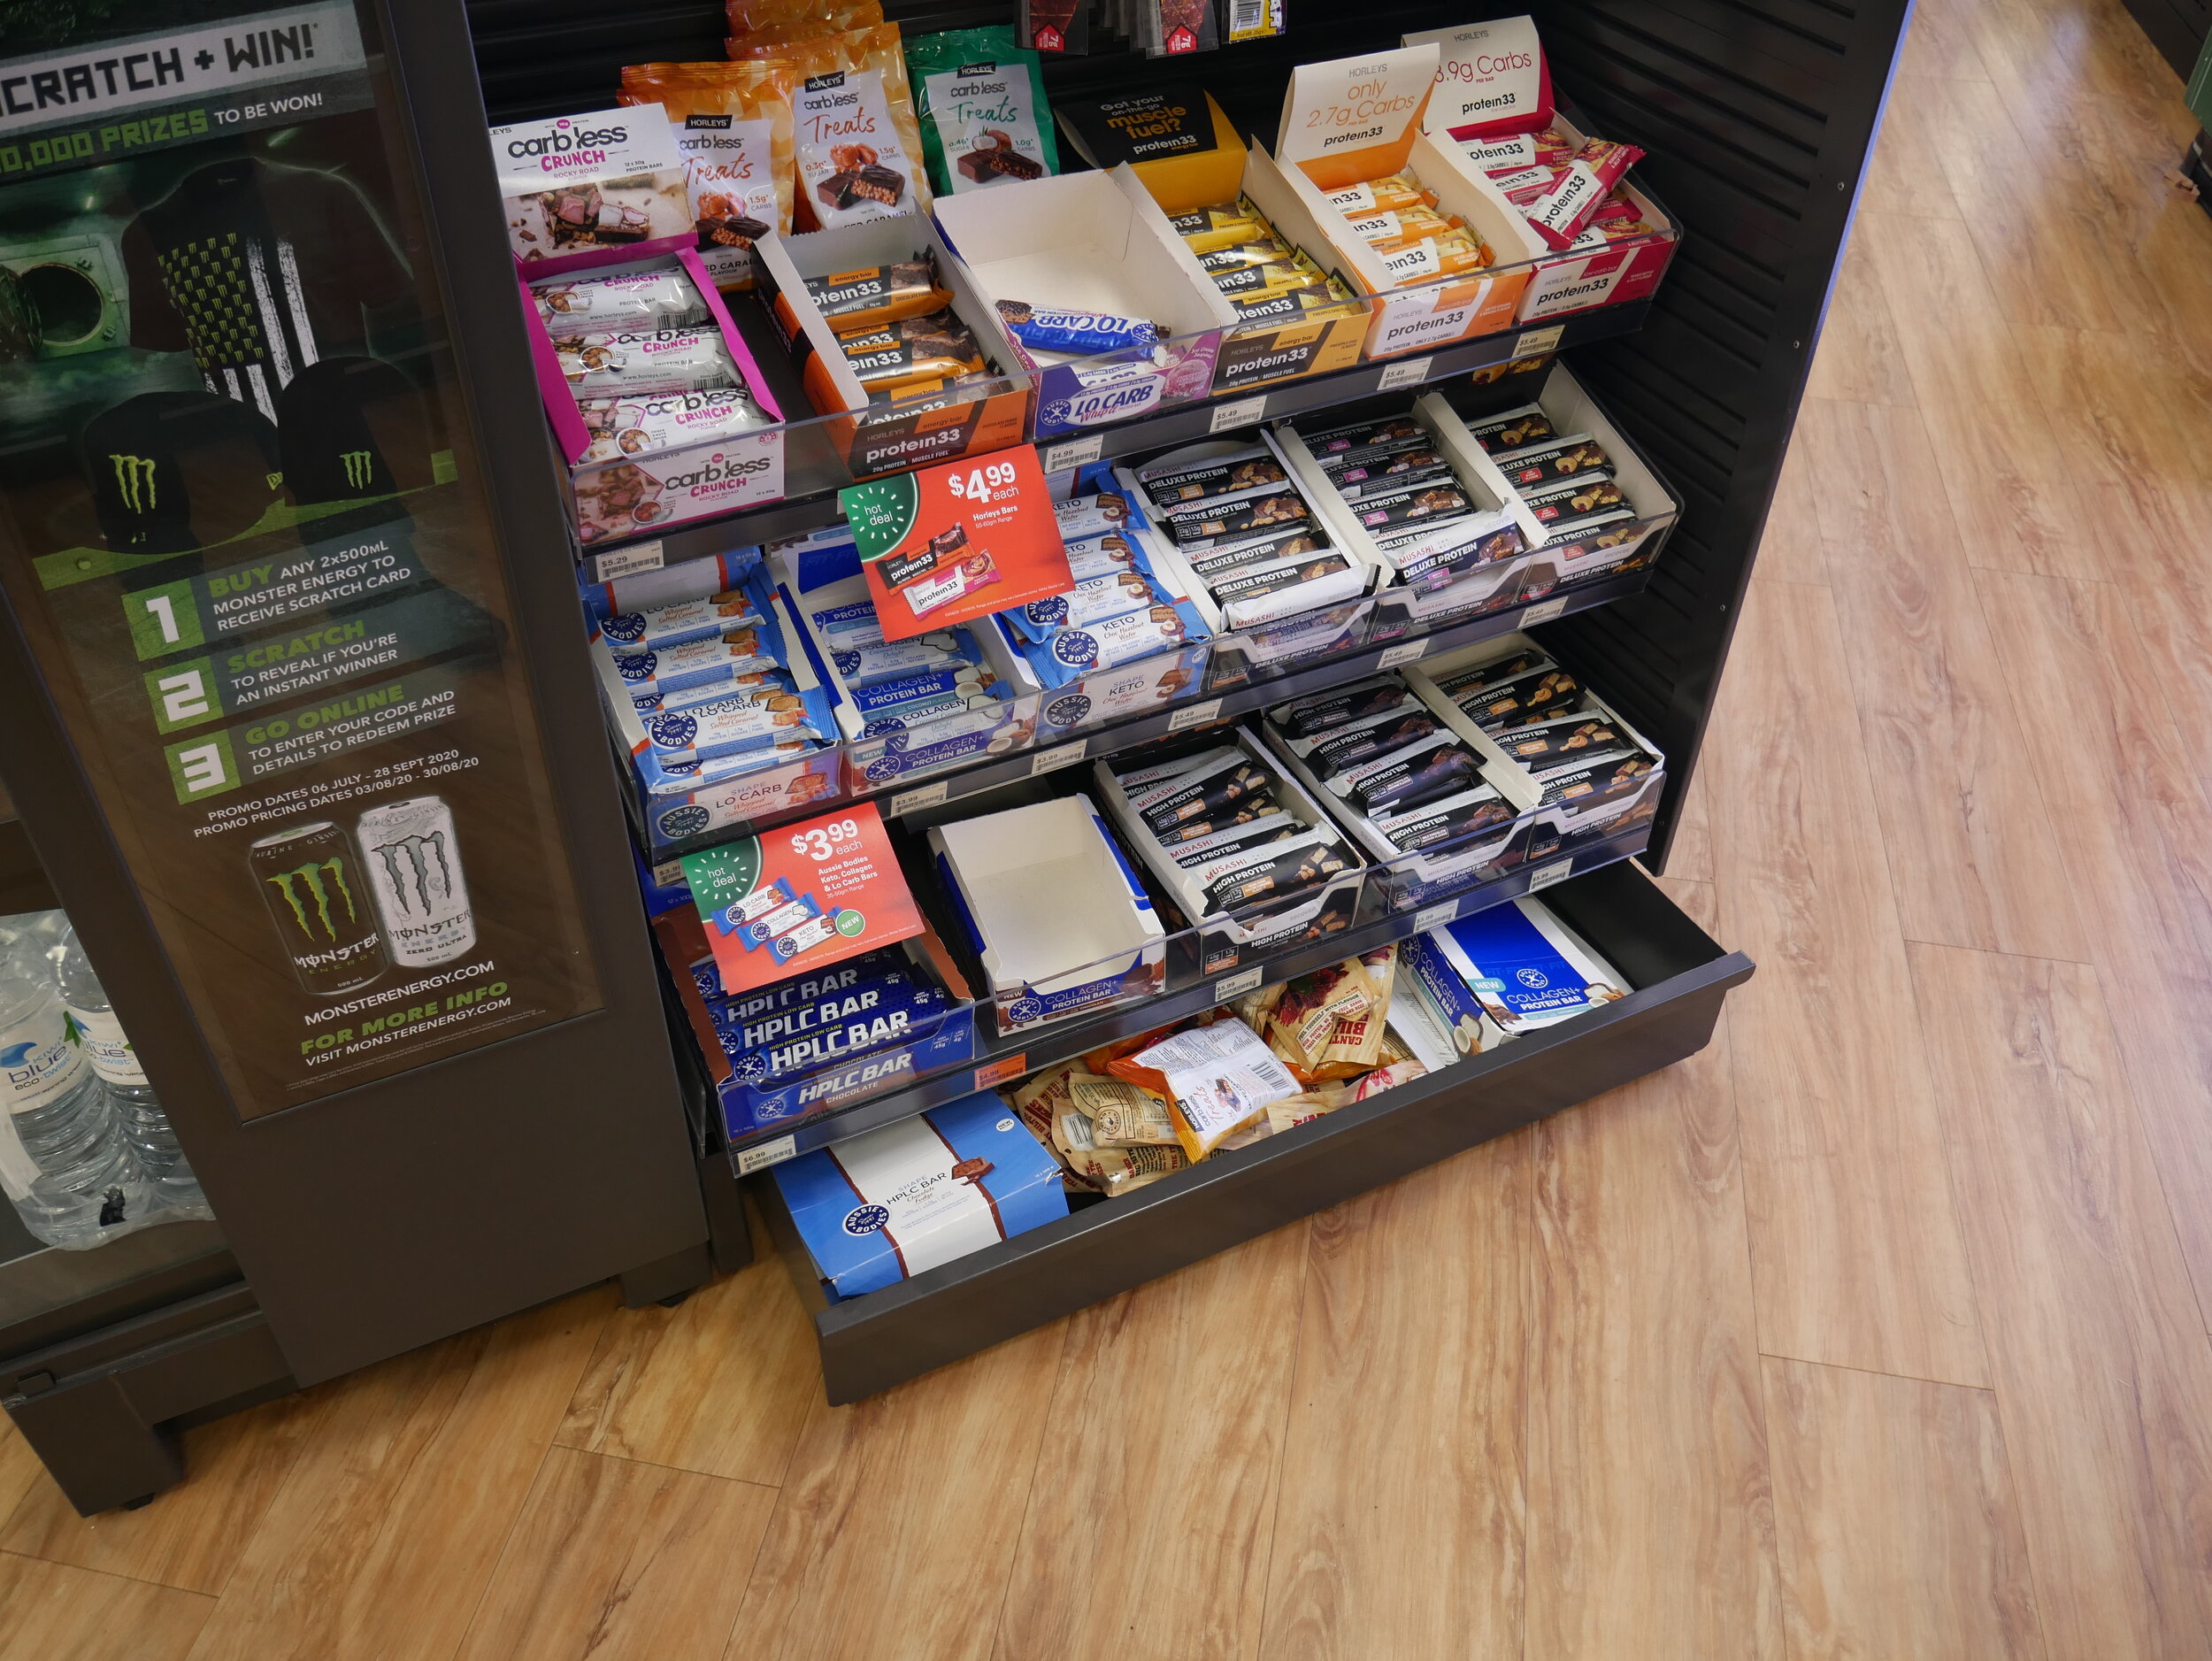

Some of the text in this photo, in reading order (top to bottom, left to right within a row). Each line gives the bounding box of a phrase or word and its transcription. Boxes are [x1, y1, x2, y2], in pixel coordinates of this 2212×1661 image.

[1454, 30, 1489, 42] HORLEYS
[1348, 64, 1387, 77] HORLEYS
[1477, 51, 1532, 75] Carbs
[0, 48, 184, 117] CRATCH
[1348, 79, 1387, 100] only
[947, 96, 1017, 124] Treats
[1101, 96, 1164, 111] Got your
[1111, 104, 1159, 116] on-the-go
[1307, 94, 1416, 127] 2.7g Carbs
[803, 106, 875, 143] Treats
[1107, 106, 1187, 128] muscle
[0, 94, 322, 173] 0,000 PRIZES TO BE WON!
[1126, 119, 1181, 139] fuel?
[541, 150, 606, 173] CRUNCH
[554, 166, 599, 180] ROCKY ROAD
[680, 152, 754, 188] Treats
[1387, 311, 1463, 341] protein33
[1226, 347, 1308, 378] protein33
[1386, 369, 1405, 379] $5.49
[1075, 384, 1153, 416] LO CARB
[1217, 410, 1237, 420] $5.49
[866, 428, 960, 464] protein33
[1052, 450, 1073, 460] $4.99
[690, 478, 747, 497] CRUNCH
[993, 487, 1018, 501] each
[864, 504, 882, 515] hot
[870, 513, 893, 526] deal
[973, 505, 1018, 520] Horleys Bars
[1564, 527, 1600, 542] PROTEIN
[602, 557, 627, 567] $5.29
[1403, 542, 1477, 579] DELUXE PROTEIN
[208, 564, 273, 601] BUY
[280, 559, 314, 580] ANY
[213, 556, 395, 615] MONSTER ENERGY TO
[1215, 568, 1298, 596] DELUXE PROTEIN
[218, 567, 411, 631] RECEIVE SCRATCH CARD
[146, 596, 179, 643] 1
[1102, 617, 1135, 630] KETO
[227, 620, 365, 673] SCRATCH
[232, 633, 398, 689] TO REVEAL IF YOU'RE
[236, 649, 398, 705] AN INSTANT WINNER
[1110, 681, 1145, 696] KETO
[1113, 674, 1143, 687] SHAPE
[158, 670, 209, 721] 2
[869, 682, 941, 705] PROTEIN BAR
[245, 684, 404, 745] GO ONLINE
[902, 699, 966, 722] COLLAGEN
[1174, 711, 1194, 720] $5.49
[248, 690, 455, 760] TO ENTER YOUR CODE AND
[253, 704, 456, 774] DETAILS TO REDEEM PRIZE
[905, 734, 984, 763] COLLAGEN+
[862, 749, 883, 759] NEW
[912, 745, 976, 768] PROTEIN BAR
[1037, 754, 1057, 764] $3.99
[179, 743, 227, 793] 3
[1556, 771, 1591, 787] PROTEIN
[208, 750, 458, 820] PROMO DATES 06 JULY 28 SEPT 2020
[1137, 785, 1177, 808] MUSASHI
[194, 757, 480, 837] PROMO PRICING DATES 03/08/20 30/08/20
[896, 796, 918, 805] $3.99
[836, 840, 863, 856] each
[708, 866, 726, 879] hot
[818, 856, 868, 875] Aussie Bodies
[820, 863, 872, 884] Keto, Collagen
[1205, 858, 1248, 881] MUSASHI
[1532, 872, 1549, 882] $5.99
[712, 874, 736, 888] deal
[841, 876, 858, 887] Carb
[860, 871, 878, 882] Bars
[849, 884, 864, 895] Range
[1213, 862, 1276, 894] HIGH PROTEIN
[841, 916, 859, 930] NEW
[1417, 913, 1433, 923] $5.99
[304, 961, 495, 1026] MONSTERENERGY.COM
[801, 968, 857, 1000] BAR
[1045, 979, 1118, 1005] COLLAGEN+
[1217, 981, 1235, 992] $5.99
[301, 981, 509, 1055] FOR MORE INFO
[743, 989, 879, 1049] HPLC BAR
[306, 1049, 342, 1066] VISIT
[346, 997, 511, 1055] MONSTERENERGY.COM
[8, 1046, 68, 1083] blue
[798, 1052, 912, 1104] HPLC BAR
[826, 1082, 879, 1104] CHOCOLATE
[743, 1151, 765, 1163] $6.99
